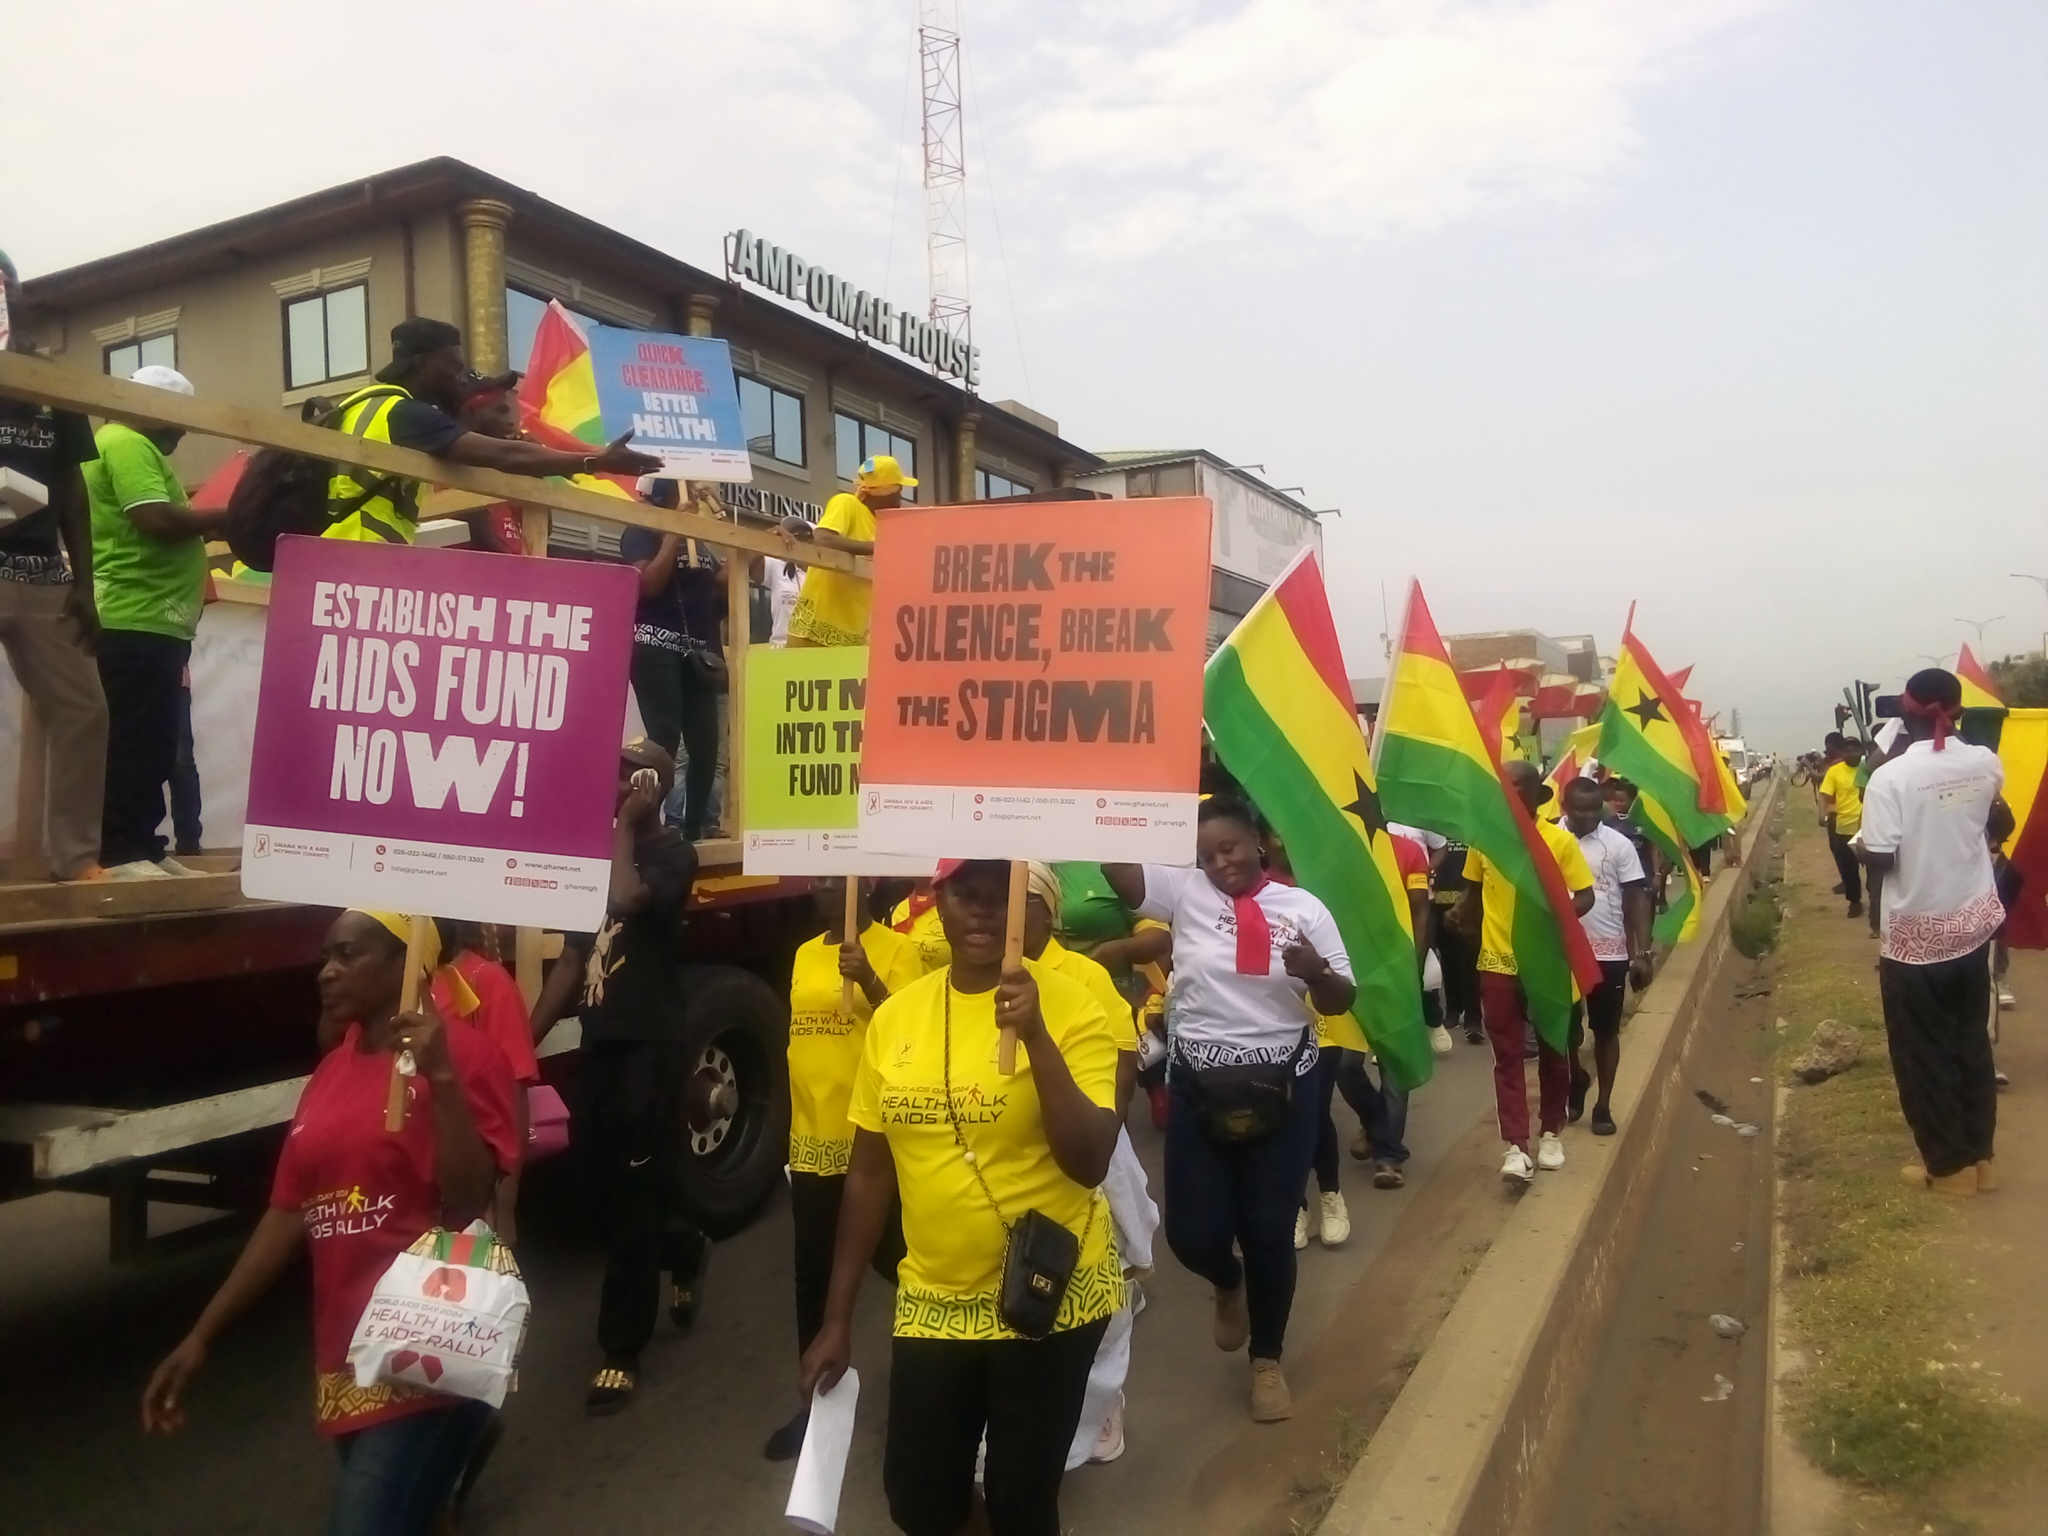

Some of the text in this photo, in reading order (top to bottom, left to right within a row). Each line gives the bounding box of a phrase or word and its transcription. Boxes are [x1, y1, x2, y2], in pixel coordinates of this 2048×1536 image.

[732, 228, 980, 386] AMPOMAH HOUSE
[637, 343, 687, 365] QUICK
[622, 364, 710, 396] CLEARANCE,
[642, 391, 699, 414] BETTER
[632, 413, 717, 441] HEALTH!
[718, 482, 771, 513] FIRST
[932, 543, 1115, 593] BREAK THE
[312, 581, 593, 651] ESTABLISH THE
[895, 603, 1176, 673] SILENCE, BREAK
[309, 634, 569, 731] AIDS FUND
[785, 679, 832, 713] PUT
[897, 678, 1155, 744] THE STIGMA
[776, 721, 826, 754] INTO
[329, 724, 530, 818] NOW!
[789, 763, 842, 796] FUND
[1113, 800, 1169, 809] www.ghanet.net
[1154, 819, 1187, 828] ghanetgh
[524, 862, 581, 873] www.ghanet.net
[564, 882, 598, 892] ghanetgh
[816, 1027, 853, 1036] RALLY
[881, 1096, 946, 1111] HEALTH
[892, 1112, 937, 1125] AIDS
[369, 1308, 438, 1328] HEALTH
[373, 1298, 464, 1318] WORLD AIDS DAY 2024
[365, 1324, 492, 1358] & AIDS RALLY
